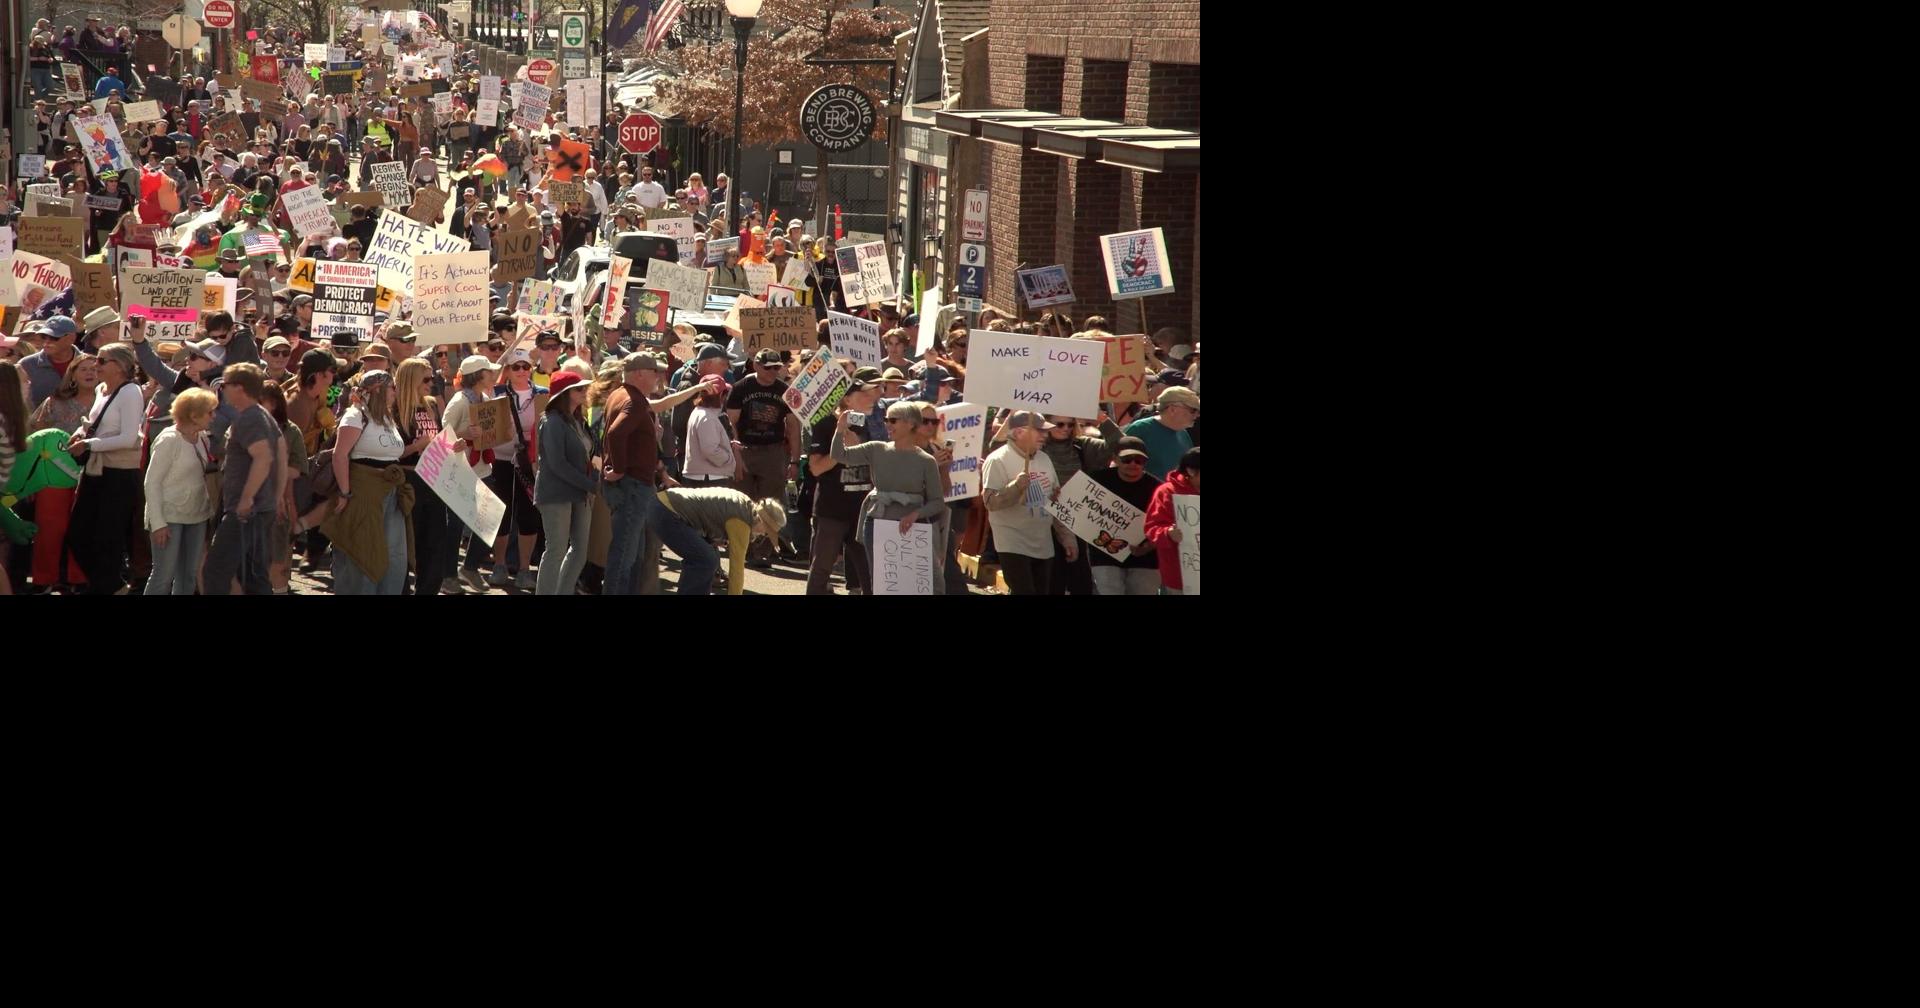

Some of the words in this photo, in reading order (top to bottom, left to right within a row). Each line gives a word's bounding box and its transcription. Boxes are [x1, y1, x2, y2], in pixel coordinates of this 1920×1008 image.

[806, 93, 828, 122] BEND
[829, 88, 872, 124] BREWING
[622, 126, 658, 142] STOP
[810, 128, 866, 149] COMPANY
[372, 163, 403, 174] REGIME
[375, 172, 406, 184] CHANGE
[376, 180, 408, 192] BEGINS
[970, 200, 982, 214] NO
[382, 214, 430, 244] HATE
[374, 232, 412, 258] NEVER
[504, 234, 532, 256] NO
[858, 244, 885, 260] STOP
[12, 260, 29, 279] NO
[323, 264, 332, 274] IN
[334, 264, 370, 278] AMERICA
[366, 250, 414, 277] AMERIC
[132, 270, 194, 285] CONSTITUTION
[326, 276, 345, 284] SHOULD
[967, 267, 976, 284] 2
[141, 287, 163, 296] LAND
[166, 287, 177, 296] OF
[179, 286, 192, 296] THE
[418, 284, 450, 296] SUPER
[455, 282, 482, 293] COOL
[1122, 280, 1156, 288] DEMOCRACY
[325, 286, 366, 300] PROTECT
[150, 296, 189, 308] FREE!
[314, 298, 374, 314] DEMOCRACY
[432, 298, 455, 310] CARE
[456, 298, 484, 308] ABOUT
[330, 314, 346, 324] FROM
[348, 316, 358, 324] THE
[416, 314, 445, 328] OTHER
[449, 312, 482, 324] PEOPLE
[759, 316, 806, 328] BEGINS
[174, 324, 192, 336] ICE
[631, 330, 664, 341] RESIST
[840, 318, 858, 328] HAVE
[860, 322, 877, 337] SEEN
[748, 334, 764, 348] AT
[773, 332, 810, 348] HOME
[832, 332, 850, 341] THIS
[853, 334, 876, 348] MOVIE
[991, 347, 1030, 358] MAKE
[1048, 350, 1089, 366] LOVE
[796, 374, 810, 392] SEE
[806, 356, 824, 378] YOU
[1023, 368, 1046, 382] NOT
[1013, 388, 1053, 404] WAR
[418, 432, 454, 486] HONK
[948, 456, 978, 472] erning
[1085, 480, 1106, 501] THE
[1112, 500, 1140, 520] ONLY
[1050, 501, 1071, 517] FUCK
[1066, 497, 1082, 512] WE
[1088, 511, 1122, 535] WANT
[1082, 496, 1130, 530] MONARCH
[1056, 512, 1076, 530] ICE!
[914, 529, 928, 548] NO
[883, 540, 900, 592] QUEEN
[916, 556, 930, 594] KINGS
